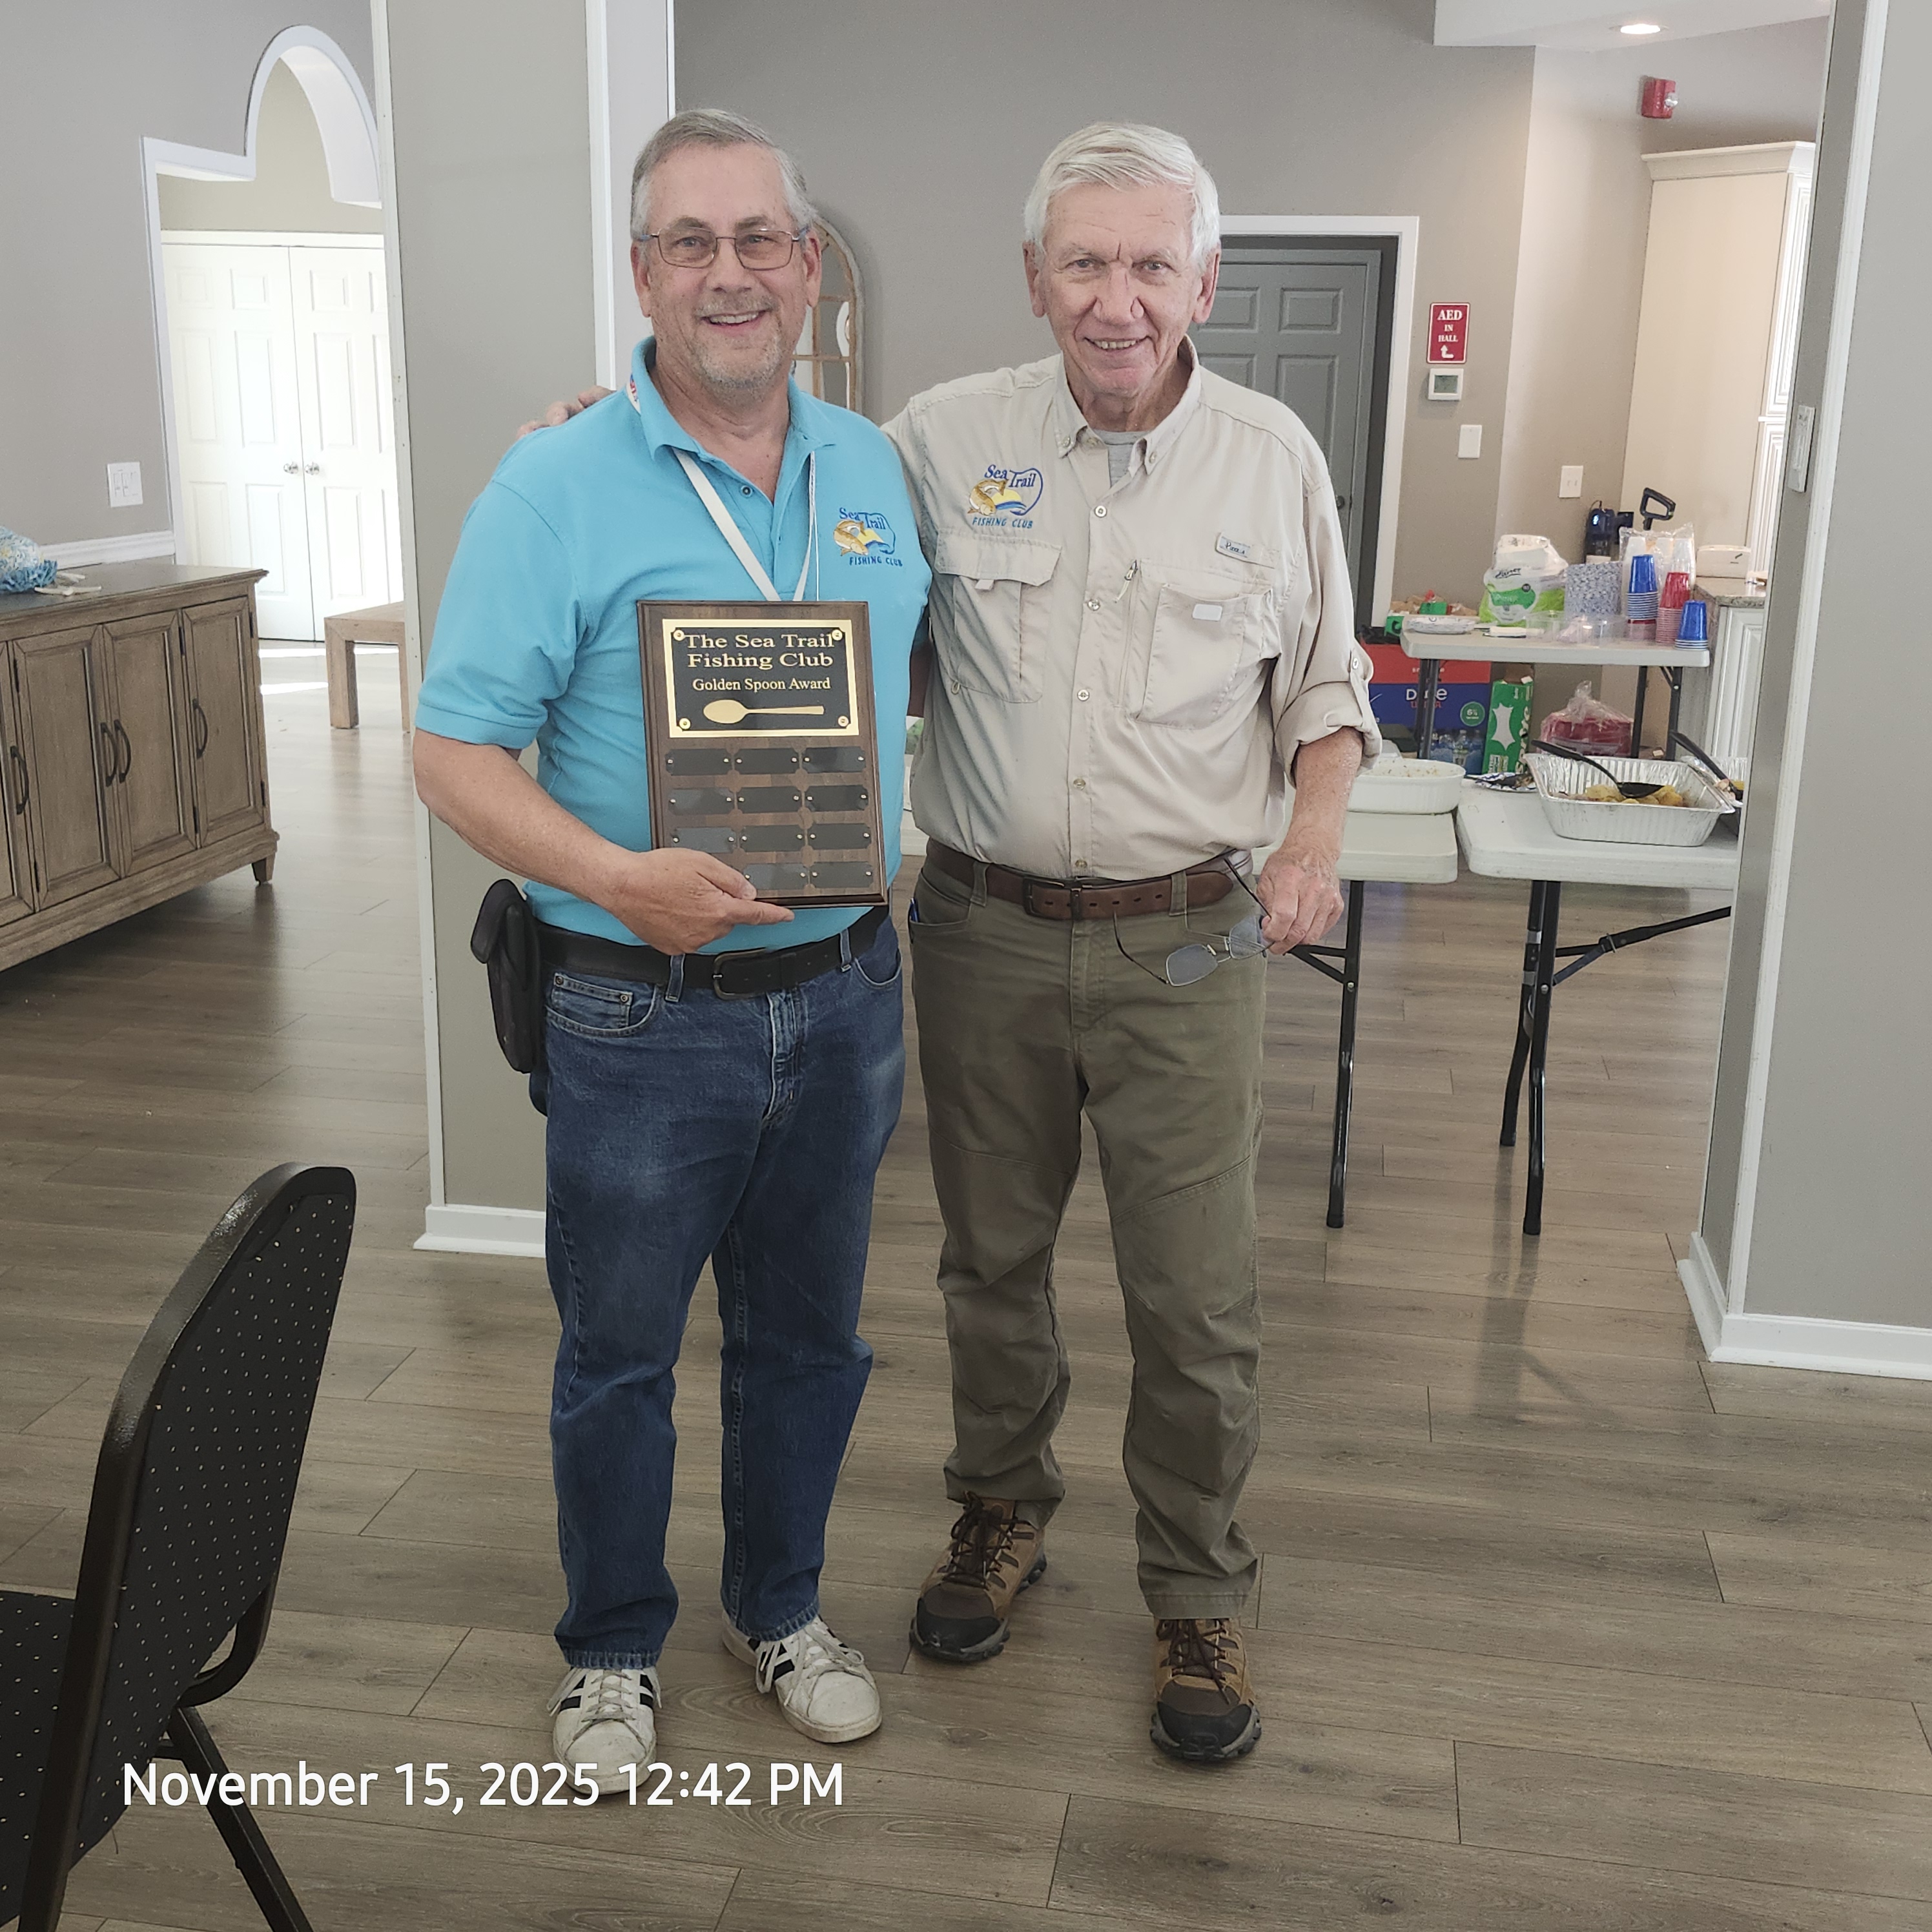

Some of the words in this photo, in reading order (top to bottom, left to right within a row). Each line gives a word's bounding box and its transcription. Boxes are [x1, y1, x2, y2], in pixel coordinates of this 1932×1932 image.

[1437, 309, 1463, 321] AED
[984, 464, 1009, 480] Sea
[1009, 469, 1037, 488] Trail
[839, 507, 861, 521] Sea
[861, 512, 886, 529] Trail
[972, 517, 1007, 526] FISHING
[1012, 519, 1034, 529] CLUB
[849, 555, 882, 566] FISHING
[885, 557, 903, 567] CLUB
[684, 634, 727, 648] The
[735, 634, 775, 648] Sea
[781, 633, 834, 648] Trail
[687, 653, 773, 670] Fishing
[779, 652, 833, 667] Club
[692, 679, 741, 691] Golden
[745, 678, 786, 692] Spoon
[788, 677, 831, 690] Award
